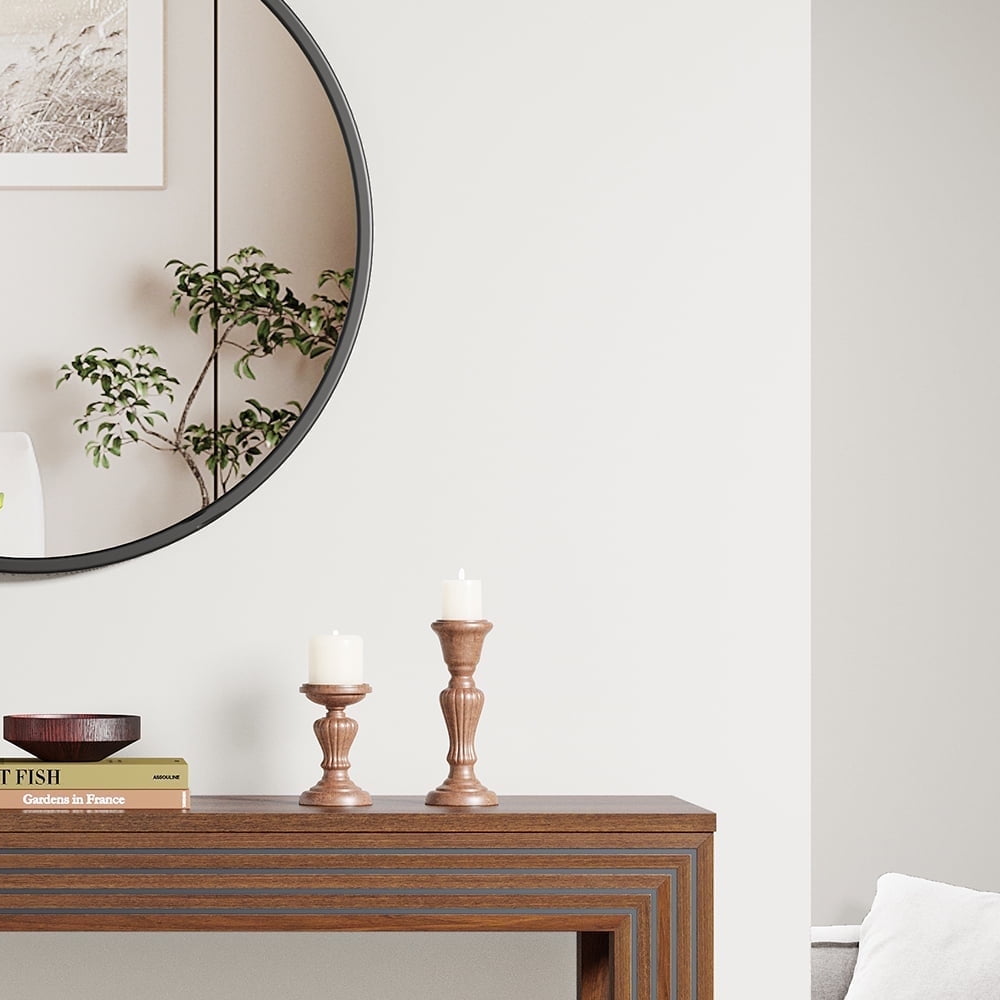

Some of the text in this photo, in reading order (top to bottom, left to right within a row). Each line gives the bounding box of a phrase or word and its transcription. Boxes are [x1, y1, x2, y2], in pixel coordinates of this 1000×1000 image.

[15, 768, 61, 785] FISH
[23, 793, 125, 805] Gardens in France
